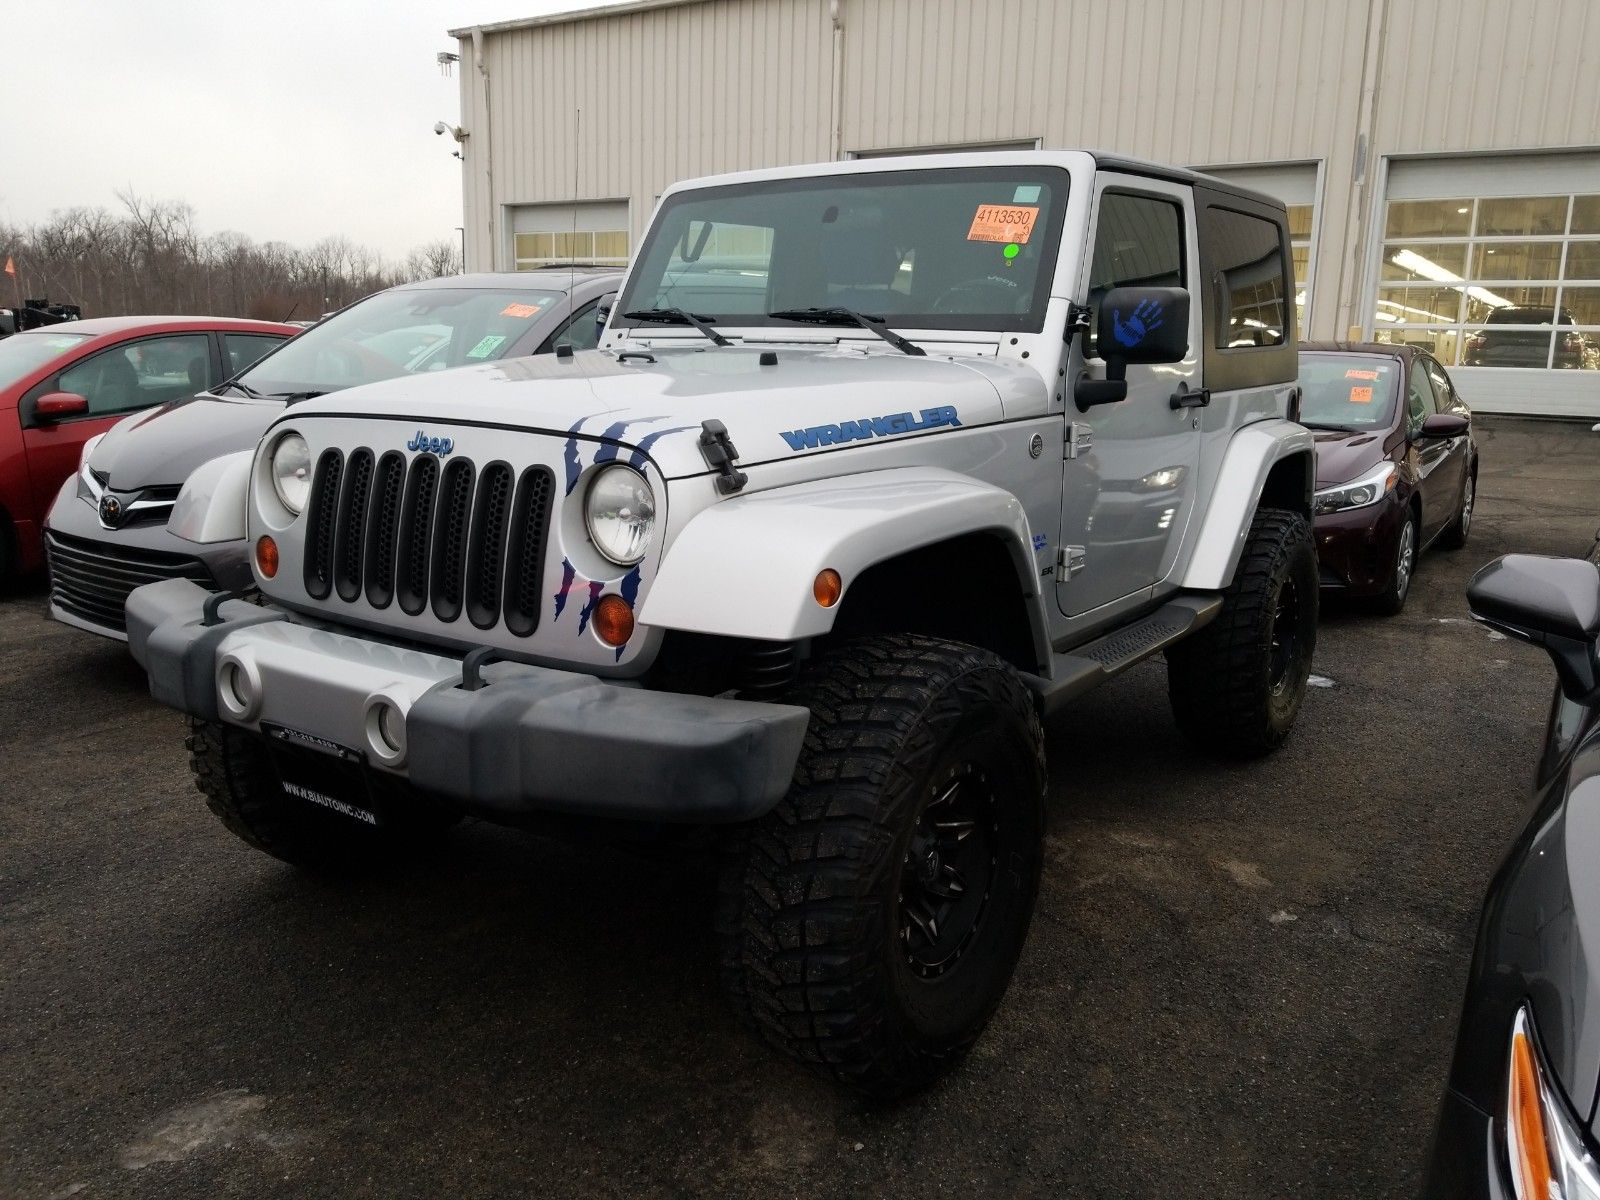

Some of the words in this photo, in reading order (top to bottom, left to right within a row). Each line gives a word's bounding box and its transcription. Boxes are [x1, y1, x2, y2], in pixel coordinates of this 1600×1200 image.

[976, 209, 1031, 225] 4113530
[779, 405, 962, 451] WRANGLER
[408, 430, 454, 458] Jeep
